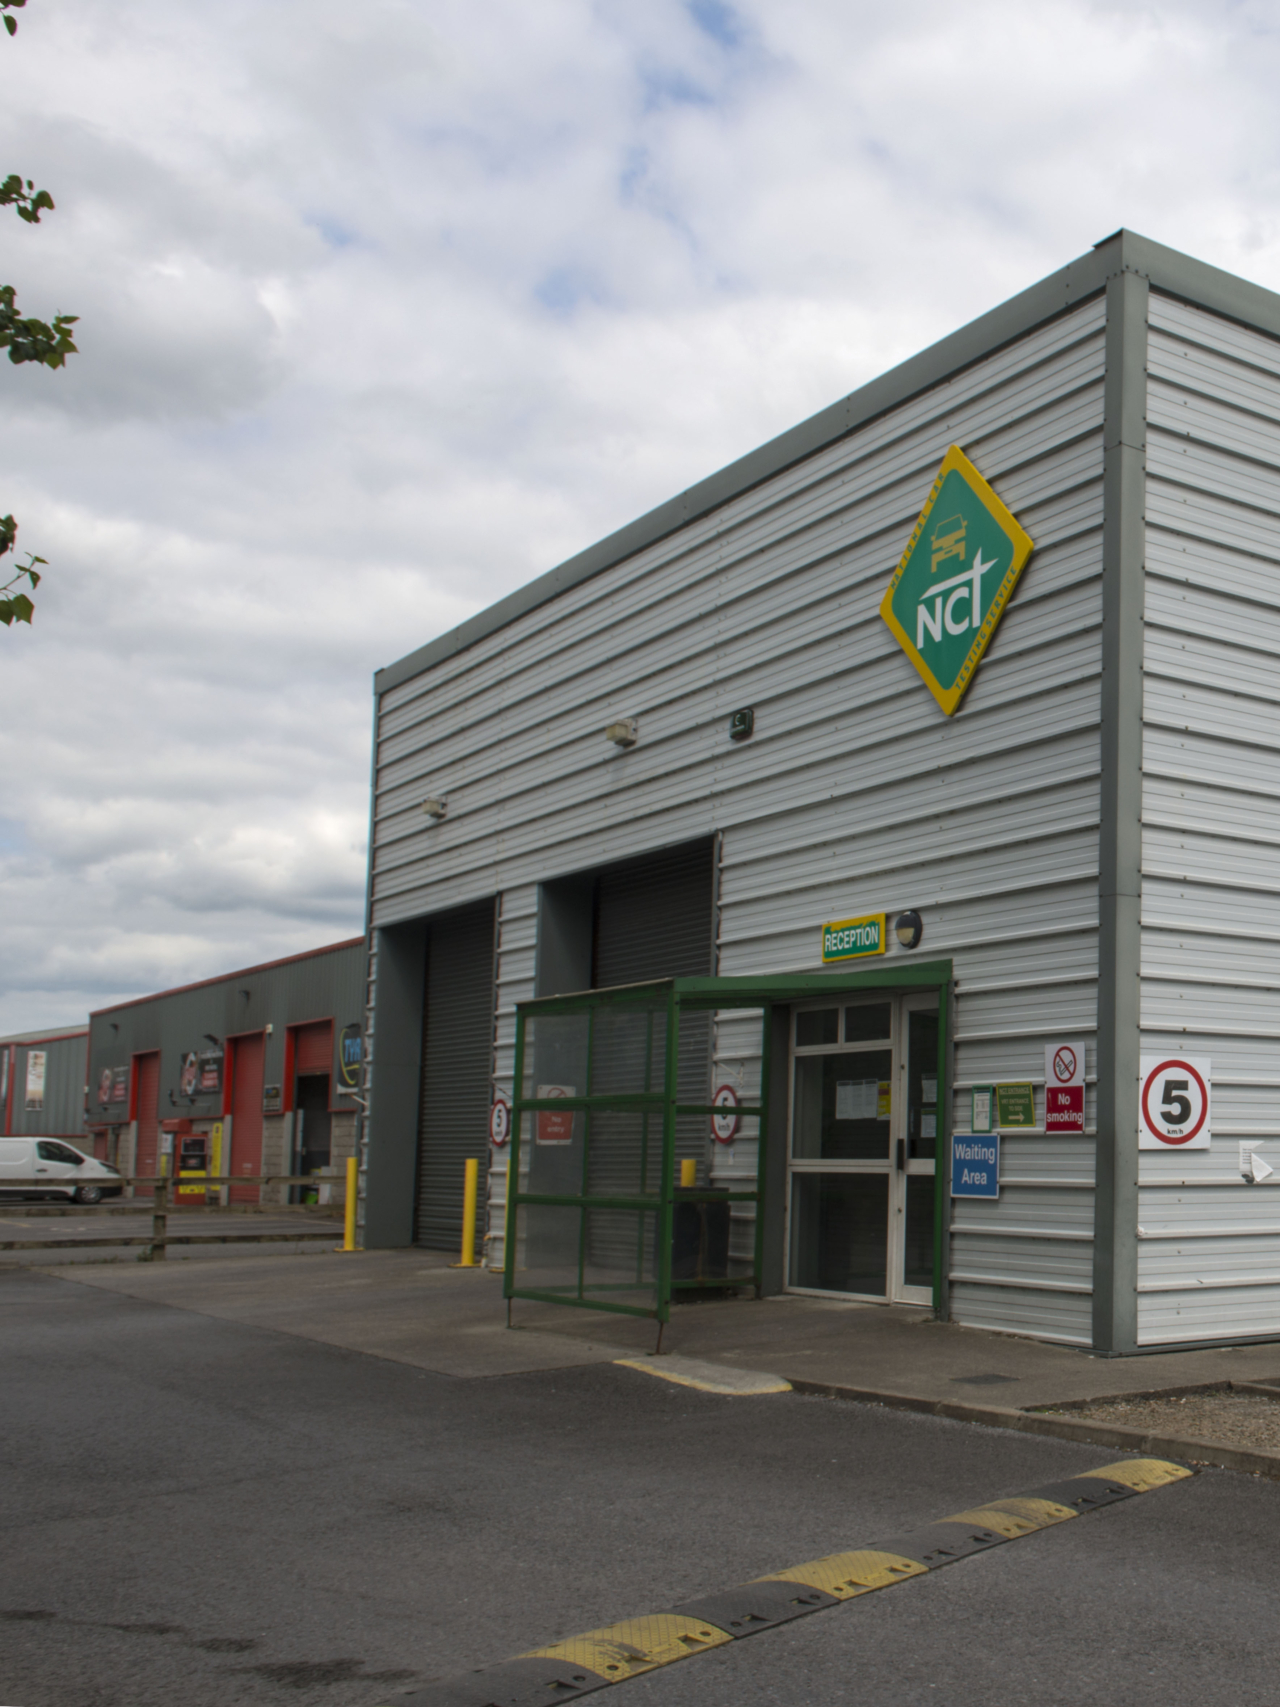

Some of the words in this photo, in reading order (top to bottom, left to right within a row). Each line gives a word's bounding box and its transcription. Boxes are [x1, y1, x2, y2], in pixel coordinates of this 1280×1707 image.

[890, 513, 927, 590] NATIONAL
[929, 472, 945, 503] CAR
[917, 546, 999, 650] NCT
[955, 631, 987, 690] TESTING
[986, 565, 1017, 628] SERVICE
[825, 925, 879, 952] RECEPTION
[1058, 1093, 1071, 1105] No
[1160, 1080, 1192, 1125] 5
[496, 1109, 502, 1127] 5
[1047, 1110, 1083, 1125] smoking
[547, 1126, 565, 1134] entry
[954, 1144, 995, 1164] Waiting
[961, 1168, 987, 1185] Area
